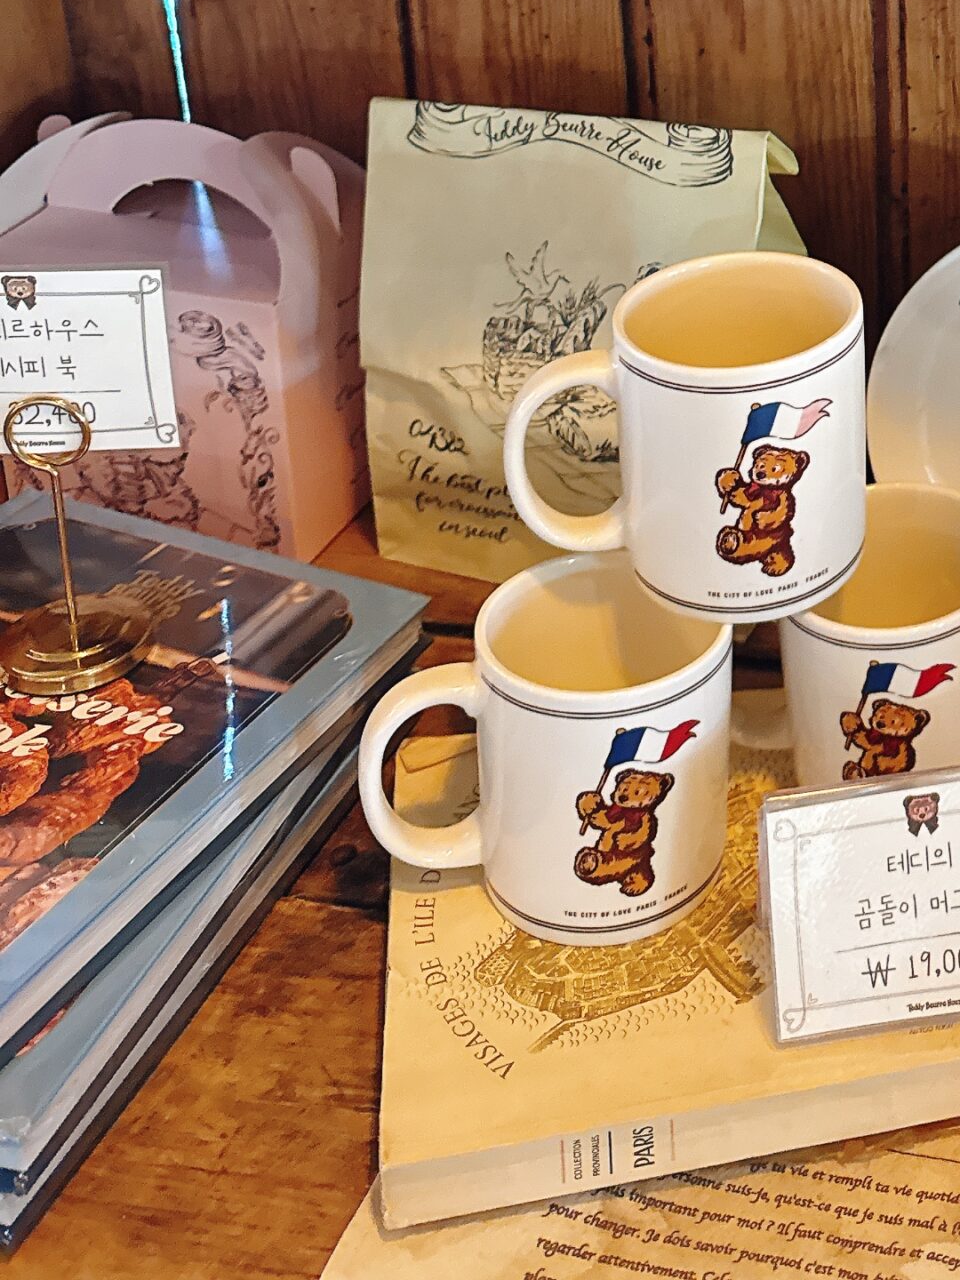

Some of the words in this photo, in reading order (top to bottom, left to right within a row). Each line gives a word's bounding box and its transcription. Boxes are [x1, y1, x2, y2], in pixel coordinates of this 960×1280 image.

[542, 111, 602, 139] Beurre
[605, 128, 666, 170] House
[0, 355, 46, 378] 시피
[56, 355, 77, 380] 북
[756, 588, 774, 597] LOVE
[778, 581, 798, 592] PARIS
[805, 567, 829, 583] FRANCE
[887, 841, 953, 875] 테디의
[564, 910, 577, 918] THE
[613, 908, 632, 917] LOVE
[636, 900, 657, 912] PARIS
[664, 884, 688, 902] FRANCE
[854, 893, 918, 931] 곰돌이
[420, 956, 448, 989] DE
[436, 997, 515, 1080] VISAGES
[572, 1138, 583, 1181] COLLECTION
[591, 1133, 601, 1177] PROVINCIALES
[632, 1125, 656, 1169] PARIS
[790, 1164, 810, 1177] vie
[812, 1170, 825, 1181] et
[827, 1175, 872, 1192] rempli
[875, 1182, 889, 1193] ta
[893, 1185, 912, 1197] vie
[657, 1172, 724, 1191] ersonne
[725, 1181, 770, 1203] suis-je,
[774, 1193, 831, 1213] qu'est-ce
[834, 1205, 859, 1219] que
[857, 1208, 874, 1224] je
[877, 1213, 904, 1226] suis
[908, 1216, 939, 1230] mal
[938, 1220, 948, 1233] à
[541, 1202, 583, 1220] pour
[583, 1211, 641, 1239] changer.
[642, 1228, 660, 1244] Je
[662, 1230, 692, 1248] dois
[693, 1240, 738, 1256] savoir
[733, 1249, 802, 1272] pourquoi
[805, 1260, 835, 1276] c'est
[838, 1268, 868, 1280] mon
[629, 1187, 700, 1216] important
[695, 1210, 736, 1225] pour
[737, 1216, 763, 1230] moi
[788, 1223, 824, 1242] faut
[826, 1233, 907, 1258] comprendre
[909, 1247, 924, 1259] et
[536, 1236, 597, 1261] regarder
